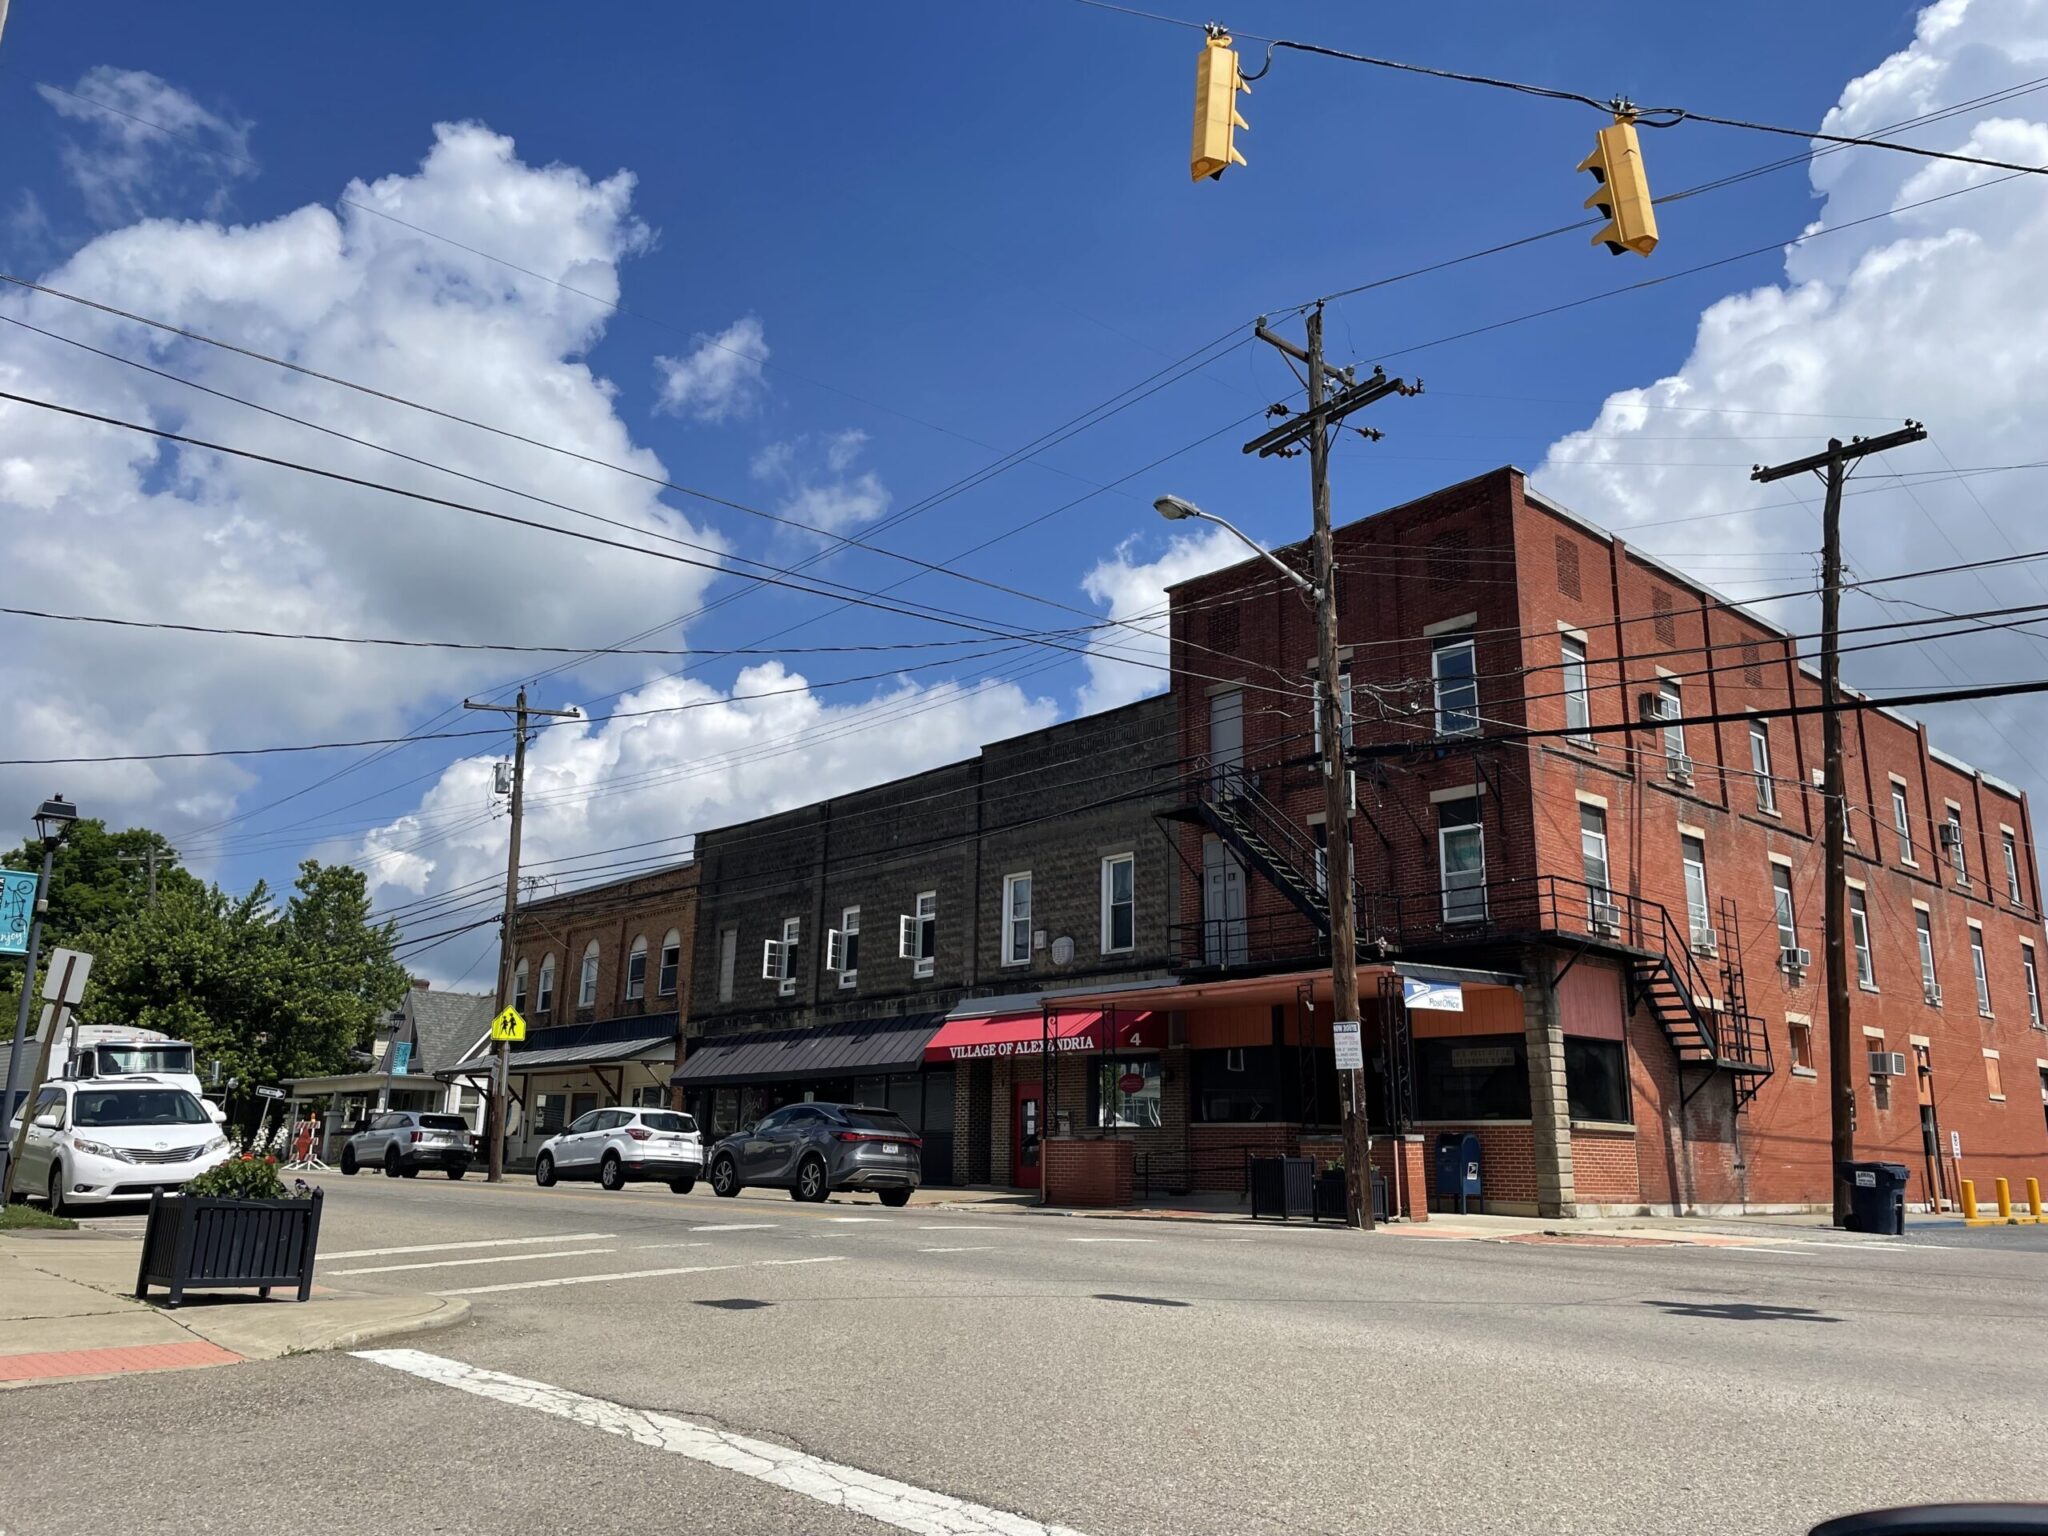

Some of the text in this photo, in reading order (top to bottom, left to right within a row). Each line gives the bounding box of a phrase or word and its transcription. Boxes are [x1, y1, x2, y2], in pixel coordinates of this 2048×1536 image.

[0, 925, 26, 946] njoy!
[950, 1036, 1094, 1059] VILLAGE OF ALEXANDRIA
[1130, 1032, 1141, 1046] 4
